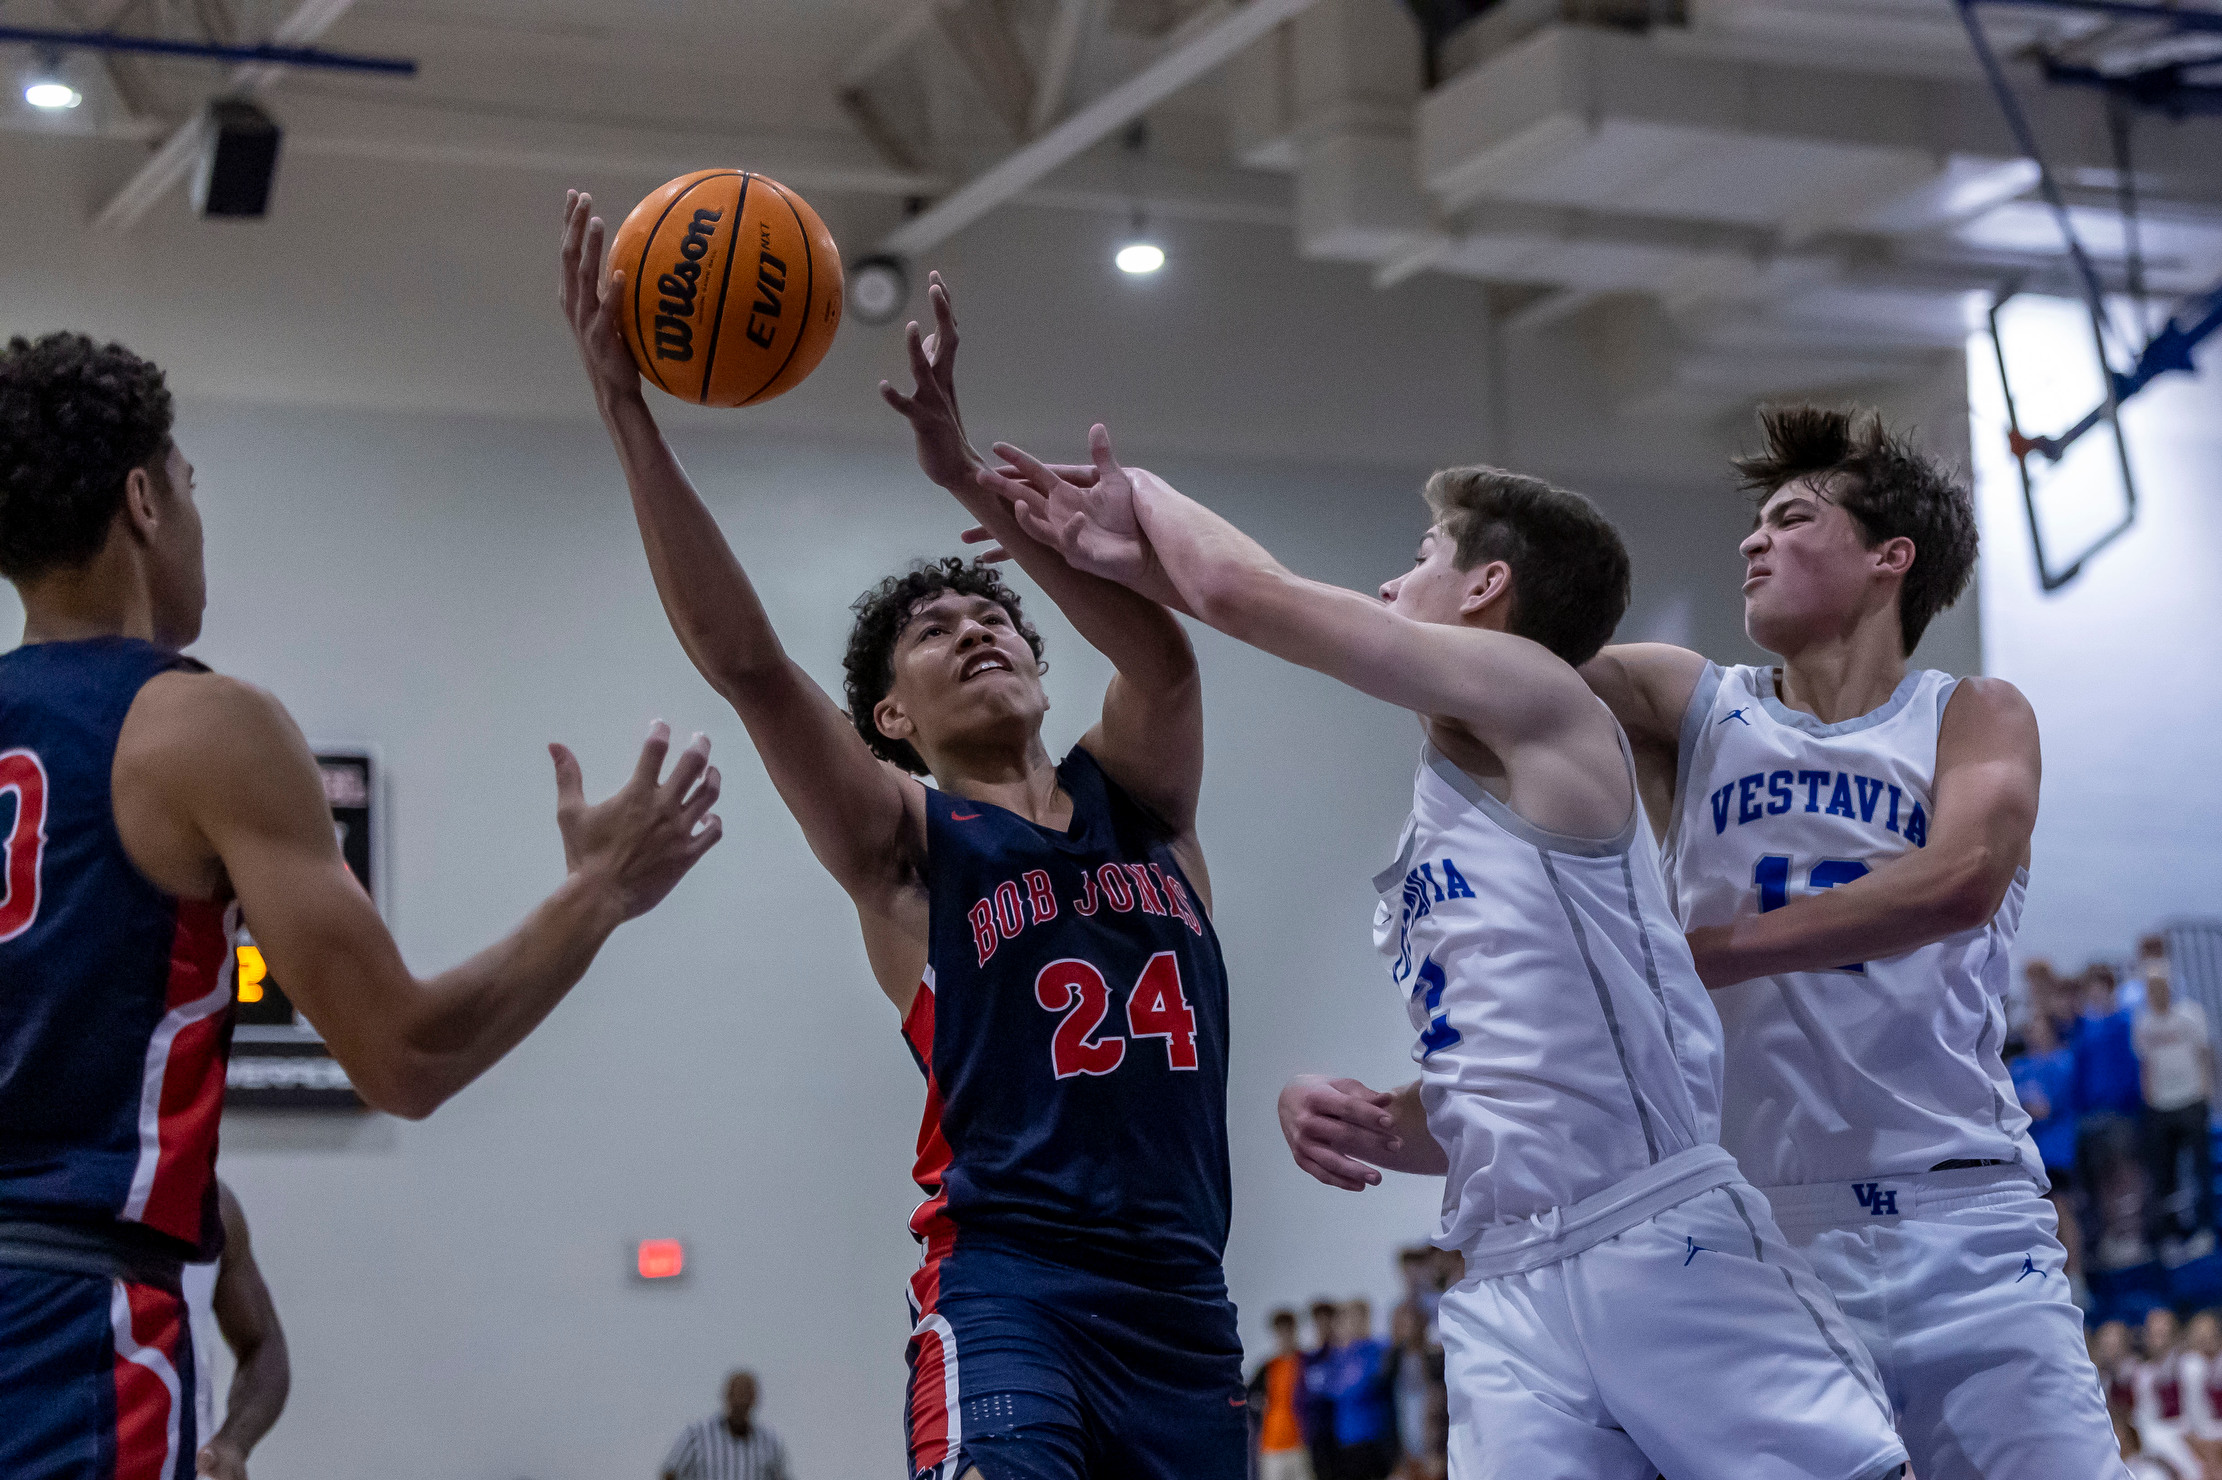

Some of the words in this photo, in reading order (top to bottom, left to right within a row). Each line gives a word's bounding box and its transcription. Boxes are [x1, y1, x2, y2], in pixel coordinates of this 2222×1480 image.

[655, 208, 724, 362] Wilson
[759, 221, 771, 251] NXT
[746, 251, 787, 350] EVO
[1711, 770, 1928, 850] VESTAVIA
[967, 869, 1058, 969] BOB
[1034, 950, 1198, 1081] 24
[1851, 1182, 1899, 1216] VH
